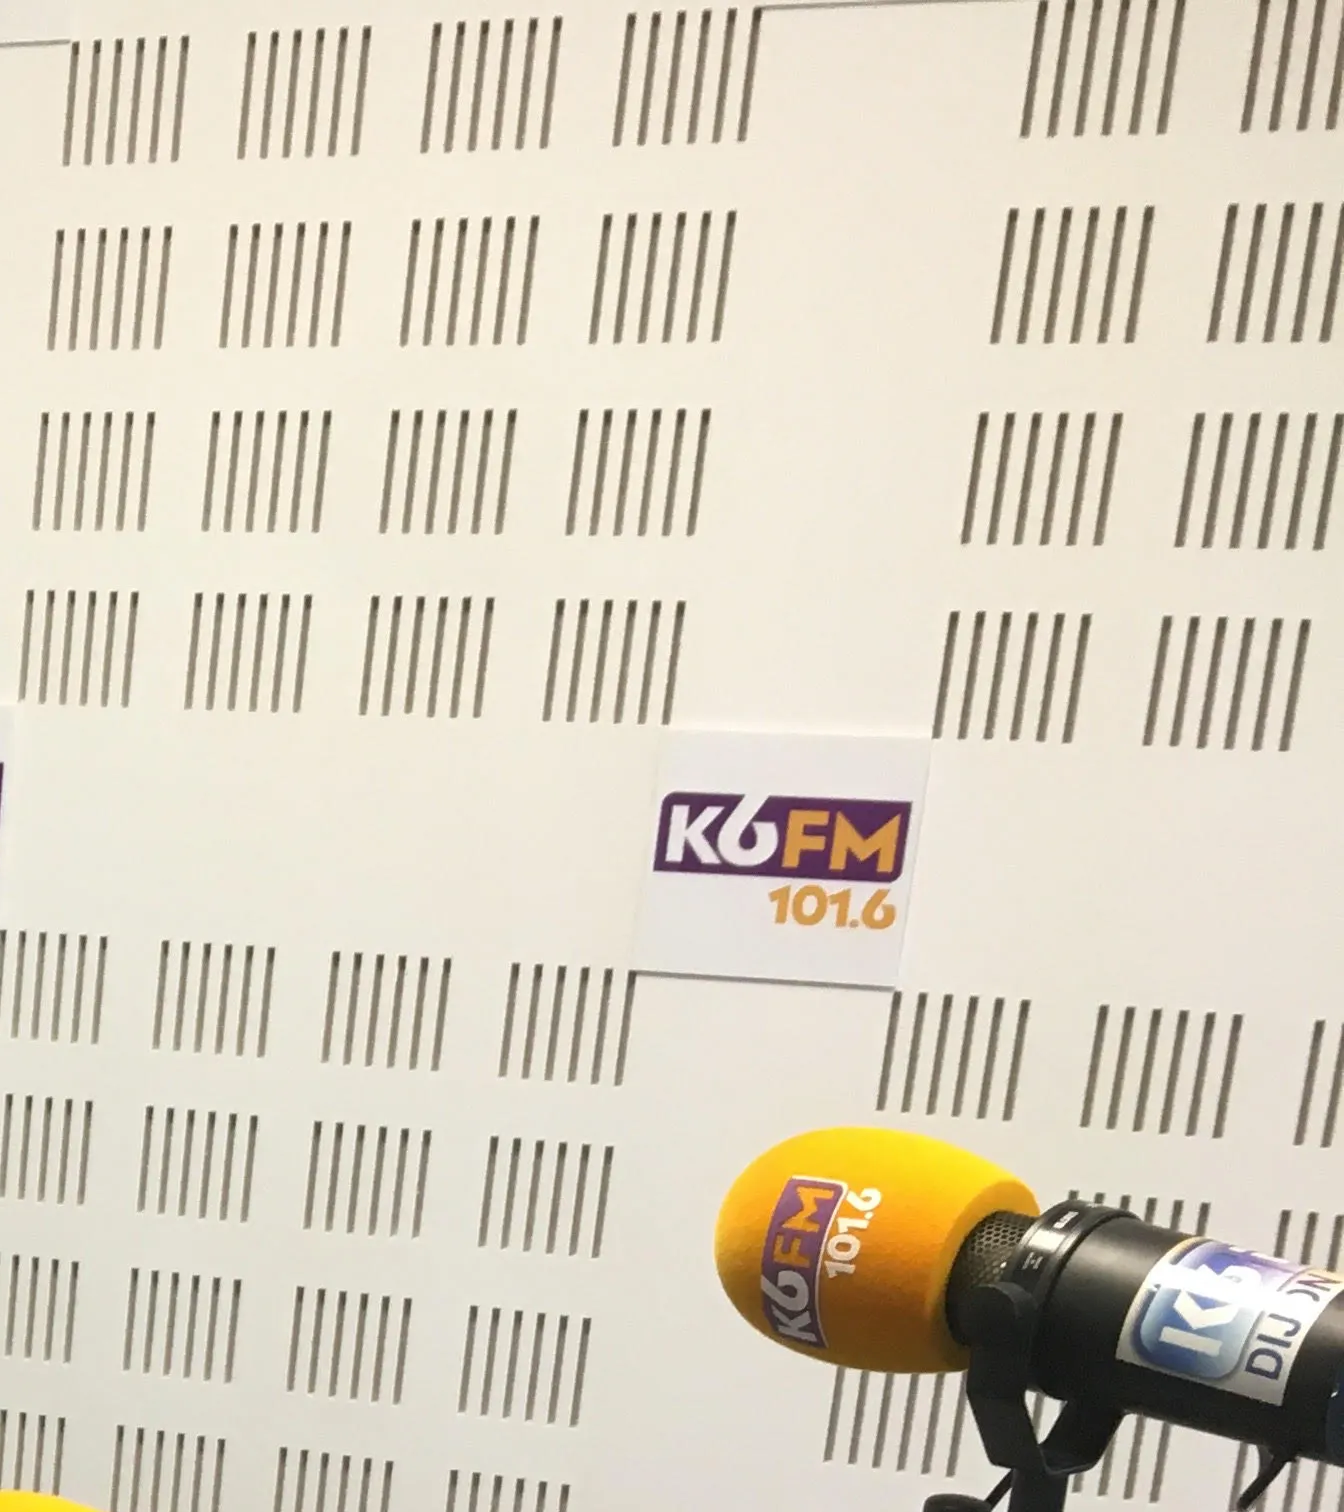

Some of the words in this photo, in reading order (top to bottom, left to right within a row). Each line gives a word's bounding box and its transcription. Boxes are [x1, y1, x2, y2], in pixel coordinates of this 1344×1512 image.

[665, 795, 902, 874] K6FM
[768, 885, 897, 930] 101.6
[760, 1186, 835, 1342] K6FM
[824, 1187, 883, 1279] 101.6
